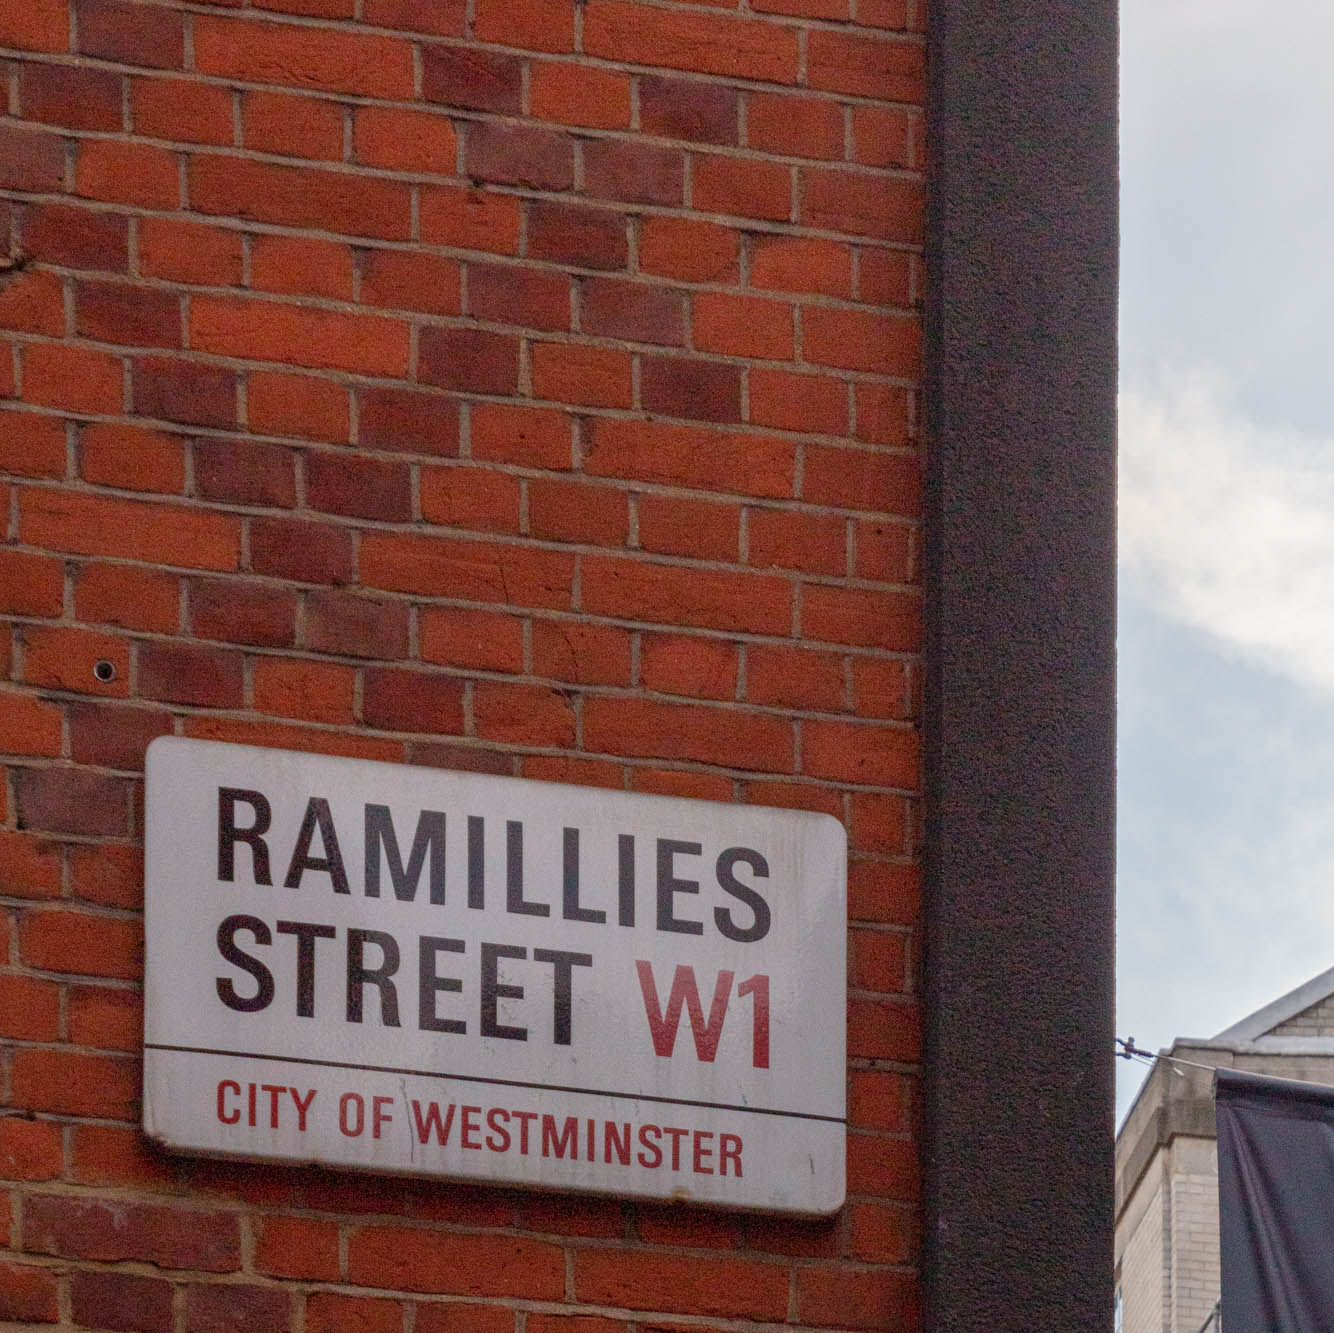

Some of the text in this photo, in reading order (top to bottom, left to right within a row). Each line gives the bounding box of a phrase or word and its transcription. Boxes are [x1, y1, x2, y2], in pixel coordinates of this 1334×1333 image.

[217, 786, 772, 943] RAMILLIES
[215, 913, 770, 1070] STREET W1
[216, 1079, 744, 1179] CITY OF WESTMINSTER
